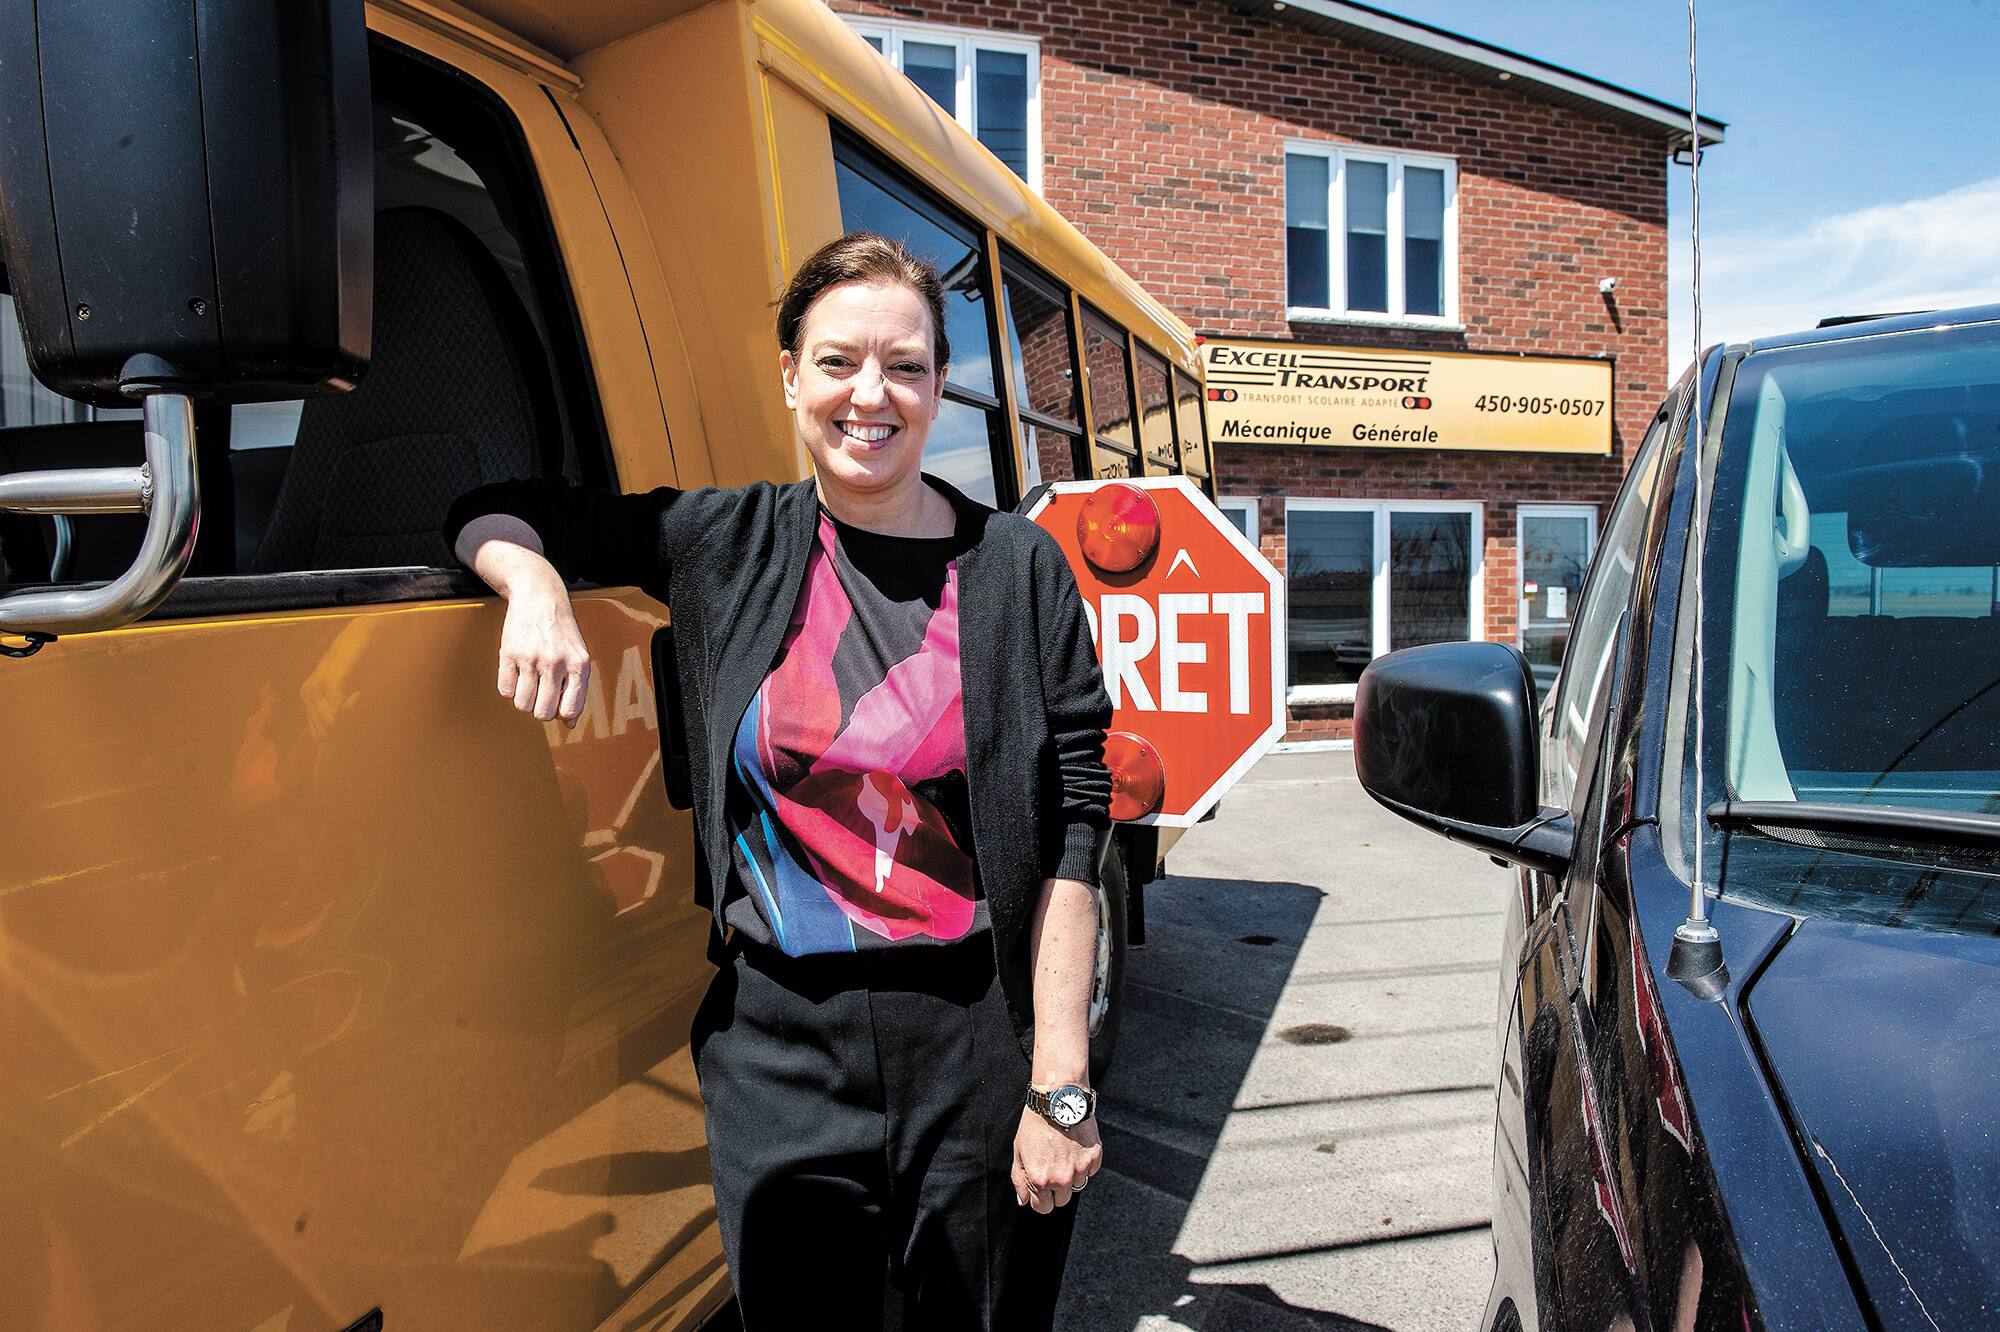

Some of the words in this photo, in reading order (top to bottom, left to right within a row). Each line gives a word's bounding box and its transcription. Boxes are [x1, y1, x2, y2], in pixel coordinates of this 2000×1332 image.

[1243, 392, 1302, 404] TRANSPORT
[1308, 395, 1356, 407] SCOLAIRE
[1361, 396, 1399, 408] ADAPTÉ
[1221, 419, 1332, 443] Mécanique
[1352, 423, 1439, 443] Générale
